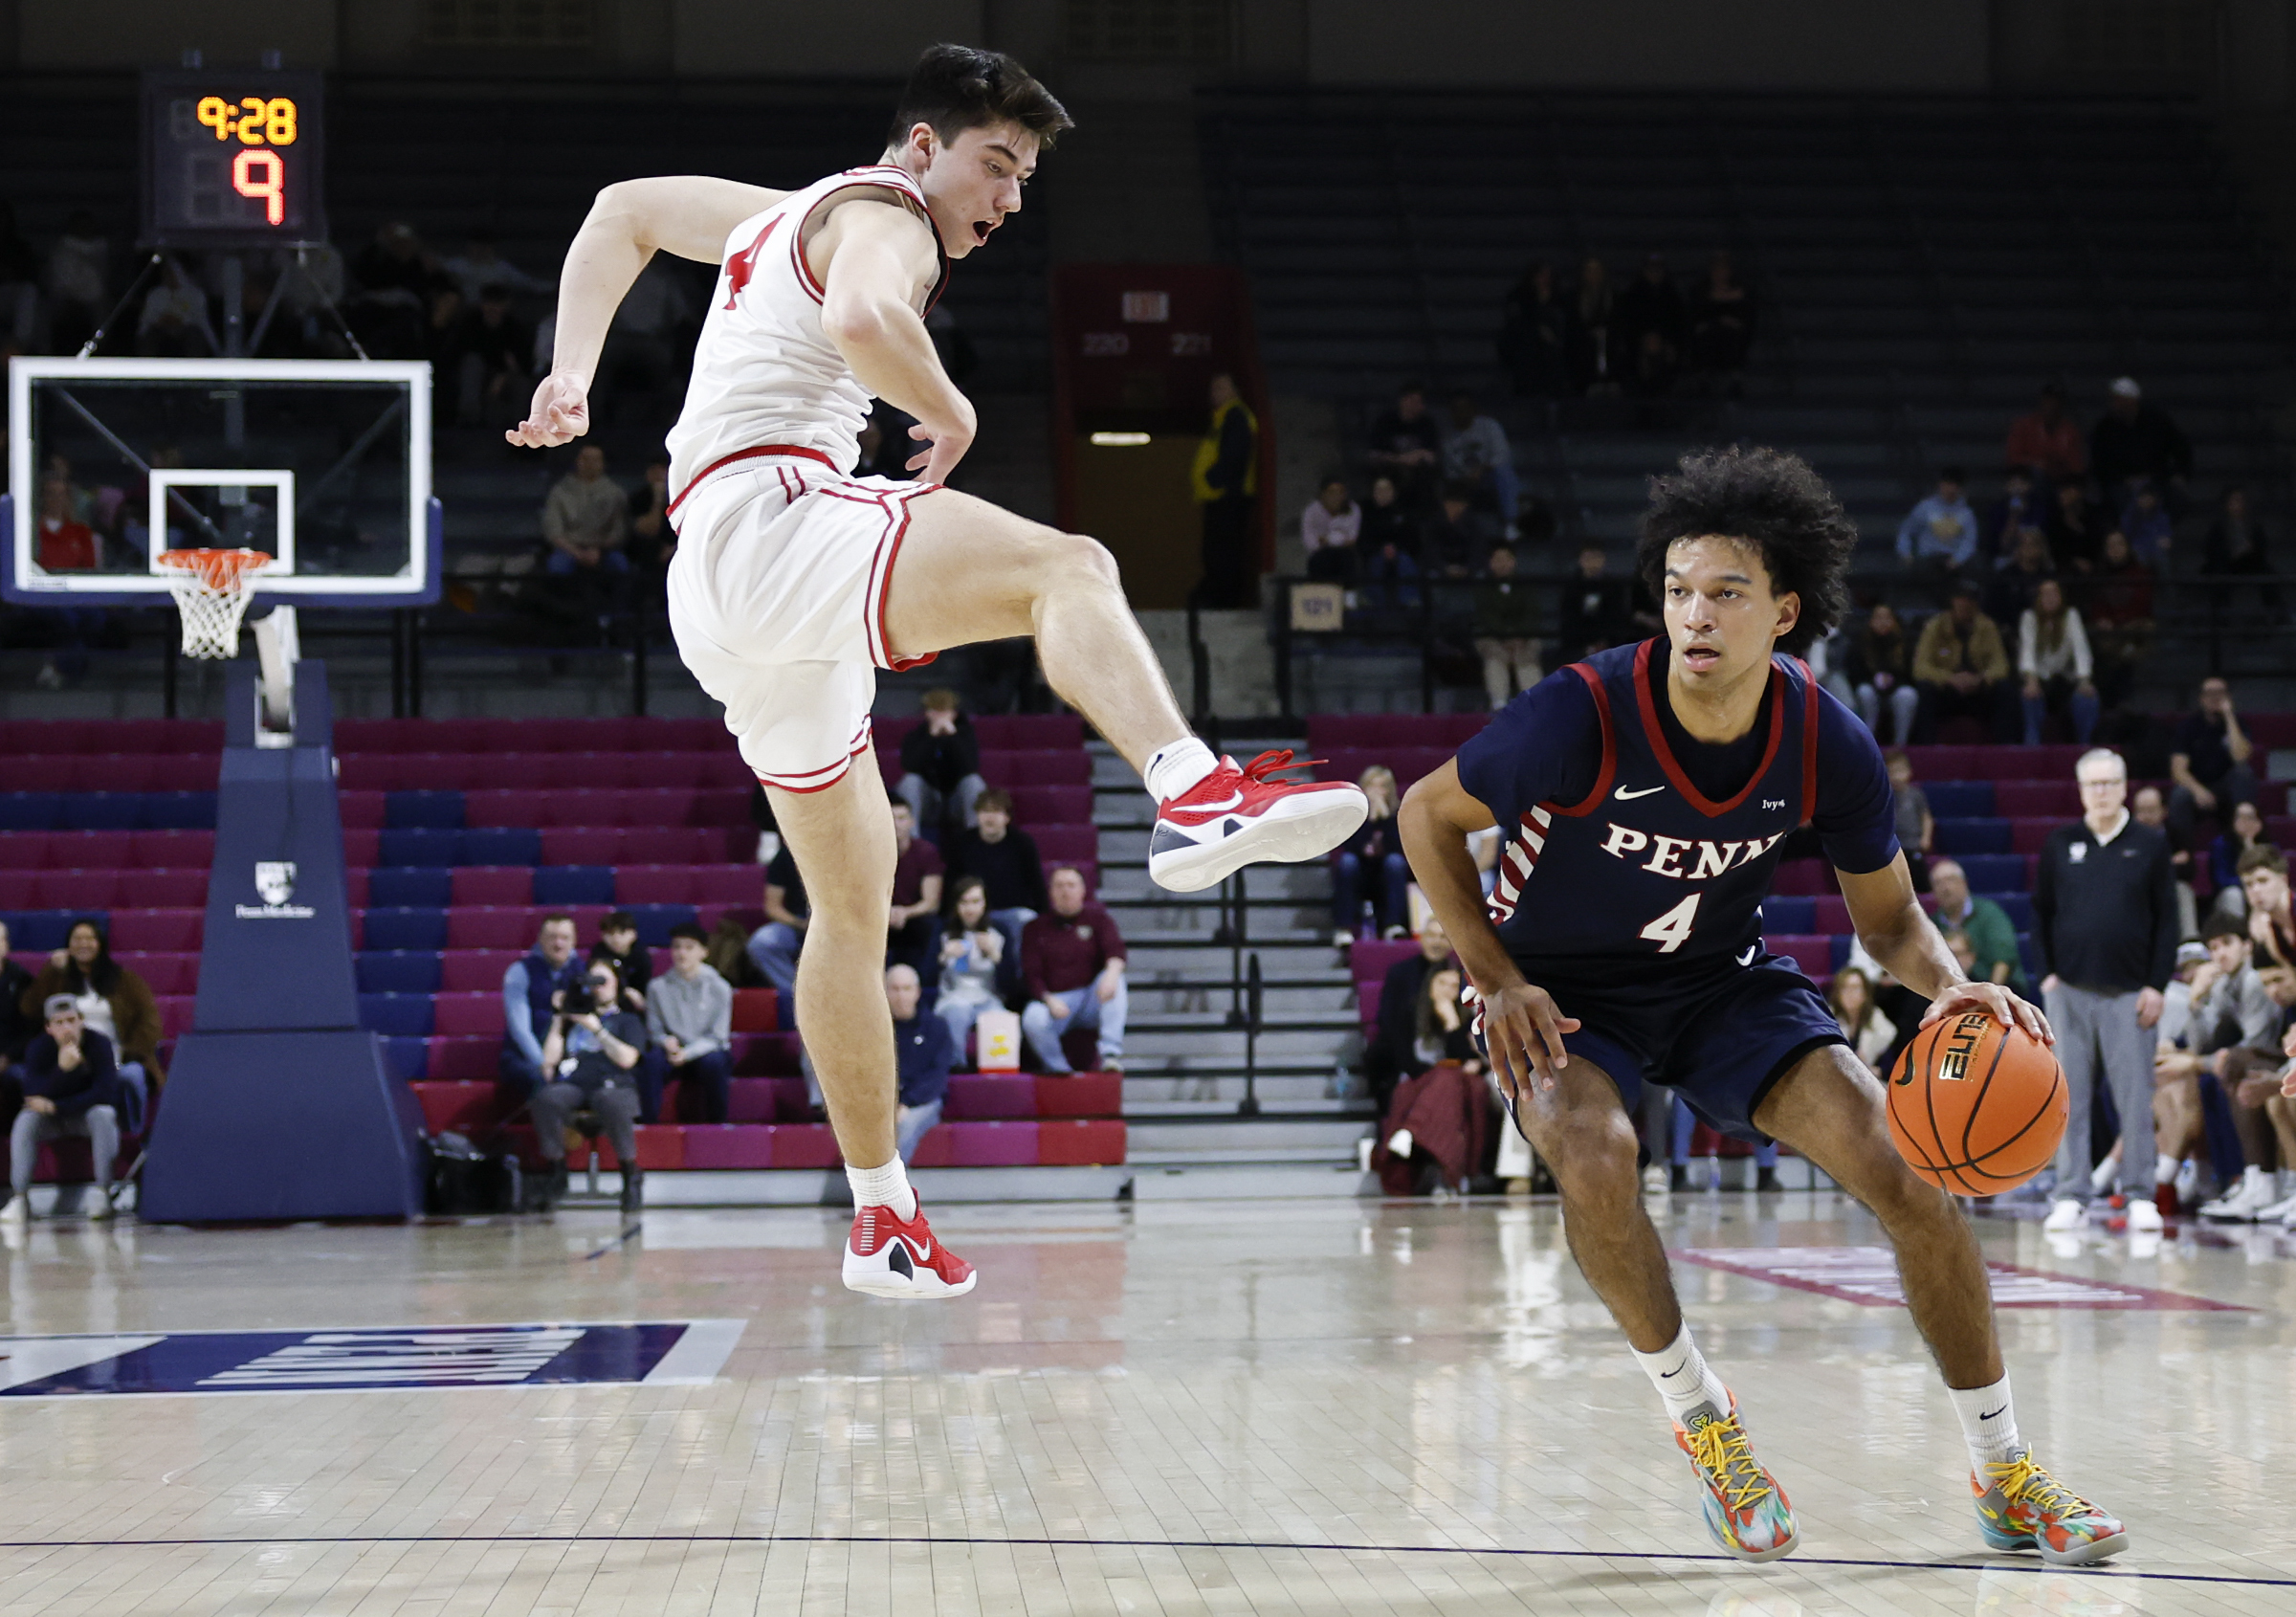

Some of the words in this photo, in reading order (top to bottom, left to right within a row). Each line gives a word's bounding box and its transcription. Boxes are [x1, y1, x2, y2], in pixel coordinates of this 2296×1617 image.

[196, 96, 298, 145] 9:28
[232, 148, 285, 226] 9
[1600, 822, 1787, 880] PENN
[1638, 892, 1704, 954] 4
[1938, 1014, 1989, 1081] ELITE
